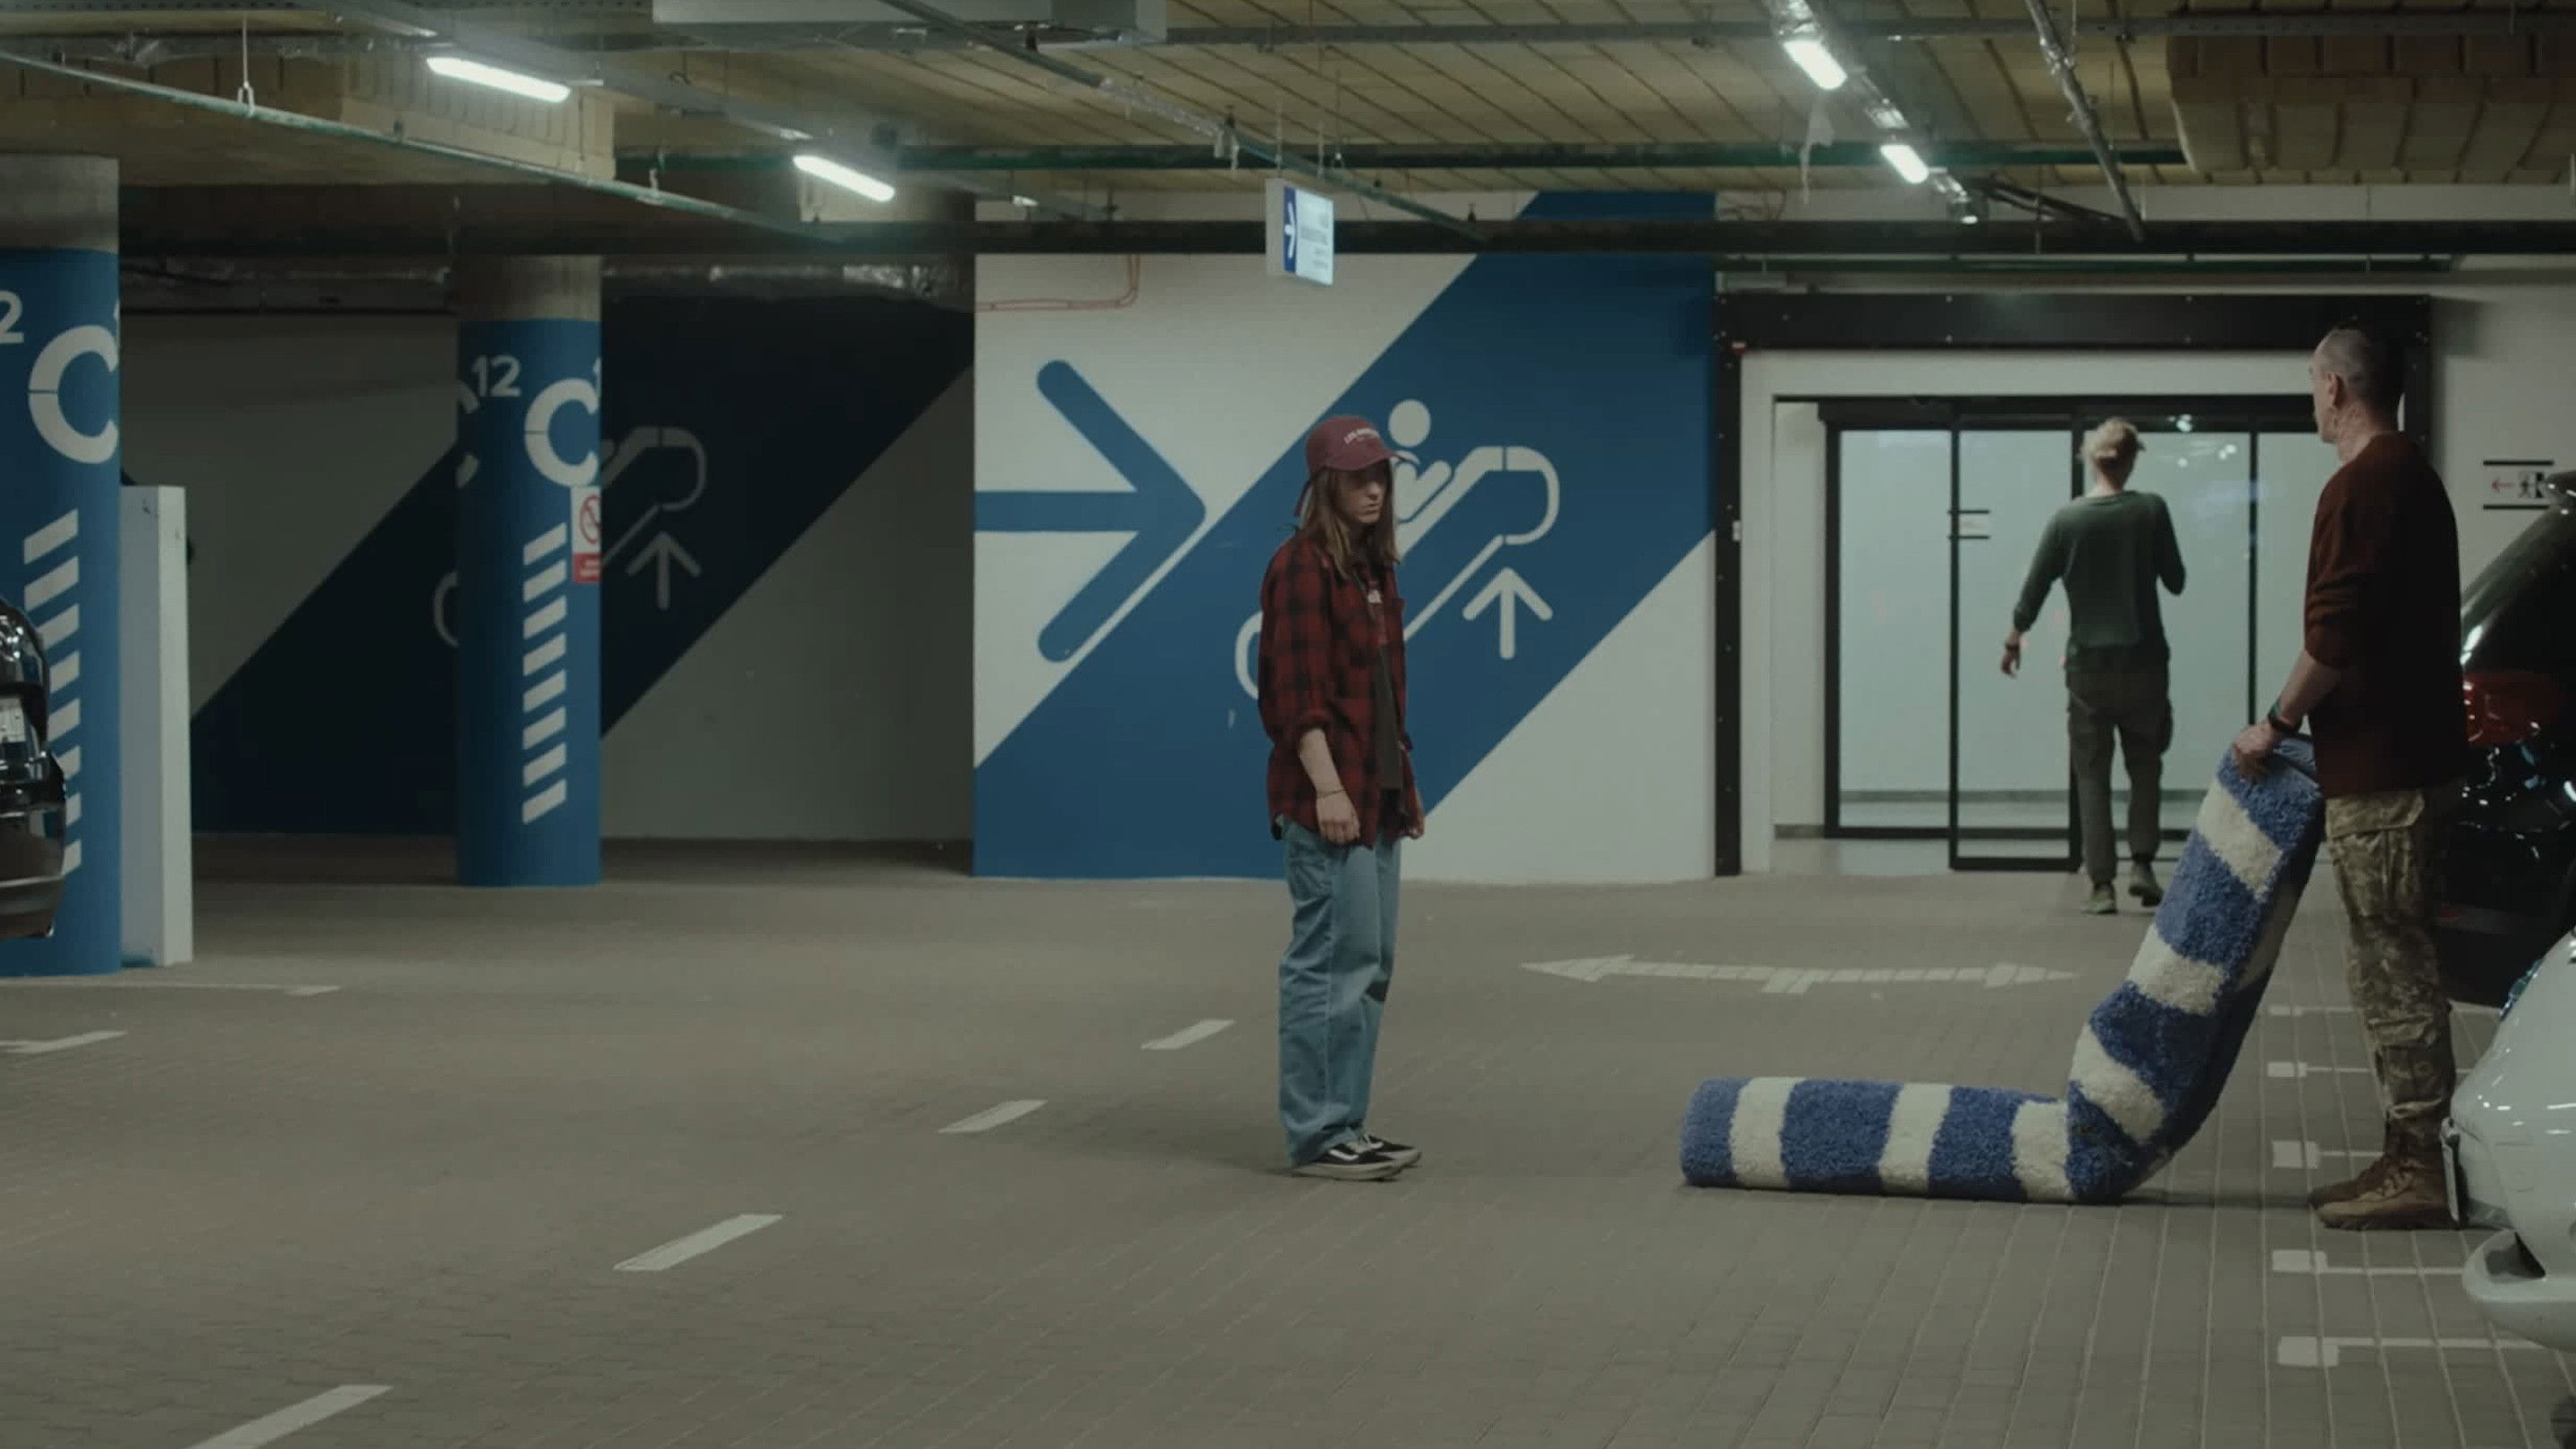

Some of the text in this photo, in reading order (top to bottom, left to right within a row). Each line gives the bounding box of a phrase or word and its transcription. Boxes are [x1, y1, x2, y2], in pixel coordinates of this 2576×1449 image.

[29, 324, 119, 464] C
[470, 354, 522, 398] 12
[524, 377, 599, 488] C
